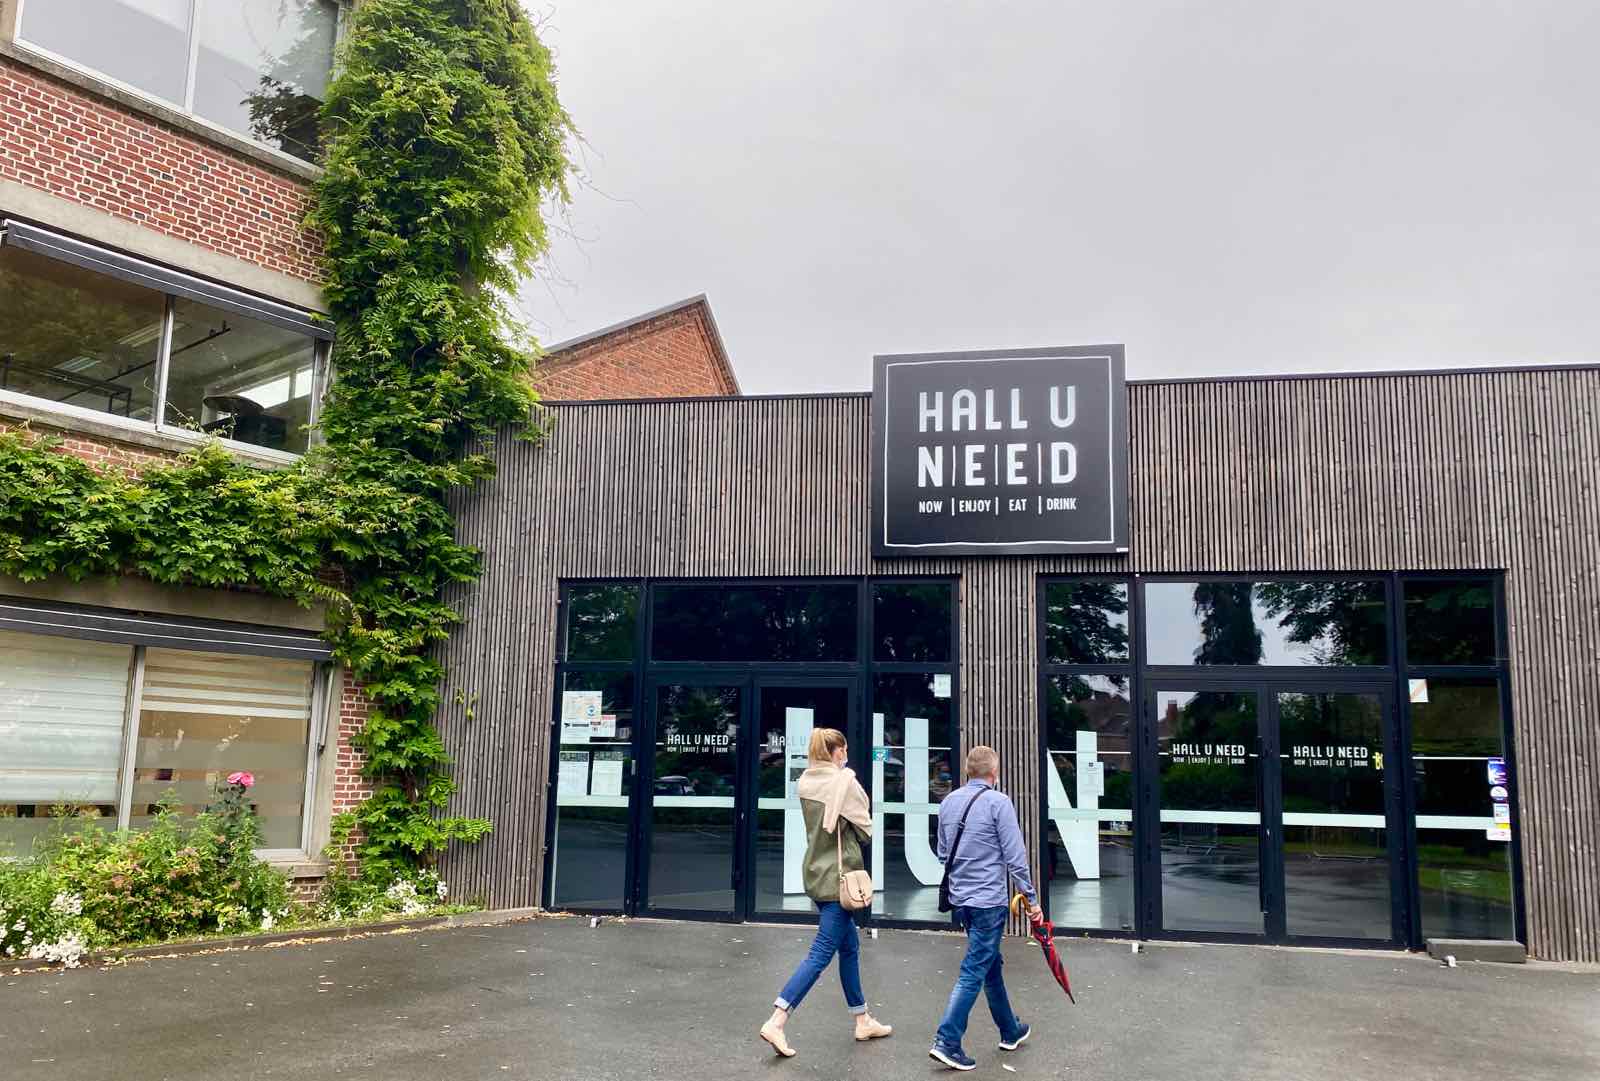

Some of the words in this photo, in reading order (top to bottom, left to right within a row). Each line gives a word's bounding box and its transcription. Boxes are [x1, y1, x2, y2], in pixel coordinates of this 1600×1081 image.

[919, 388, 1028, 433] HALL
[1049, 385, 1076, 428] U
[919, 501, 943, 513] NOW
[959, 499, 991, 513] ENJOY
[1008, 498, 1027, 512] EAT
[1046, 497, 1077, 511] DRINK
[667, 734, 691, 745] HALL
[694, 734, 701, 745] U
[704, 734, 729, 746] NEED
[1172, 743, 1201, 755] HALL
[1204, 744, 1212, 755] U
[1216, 744, 1245, 757] NEED
[1293, 745, 1323, 758] HALL
[1326, 746, 1334, 758] U
[1338, 746, 1368, 759] NEED
